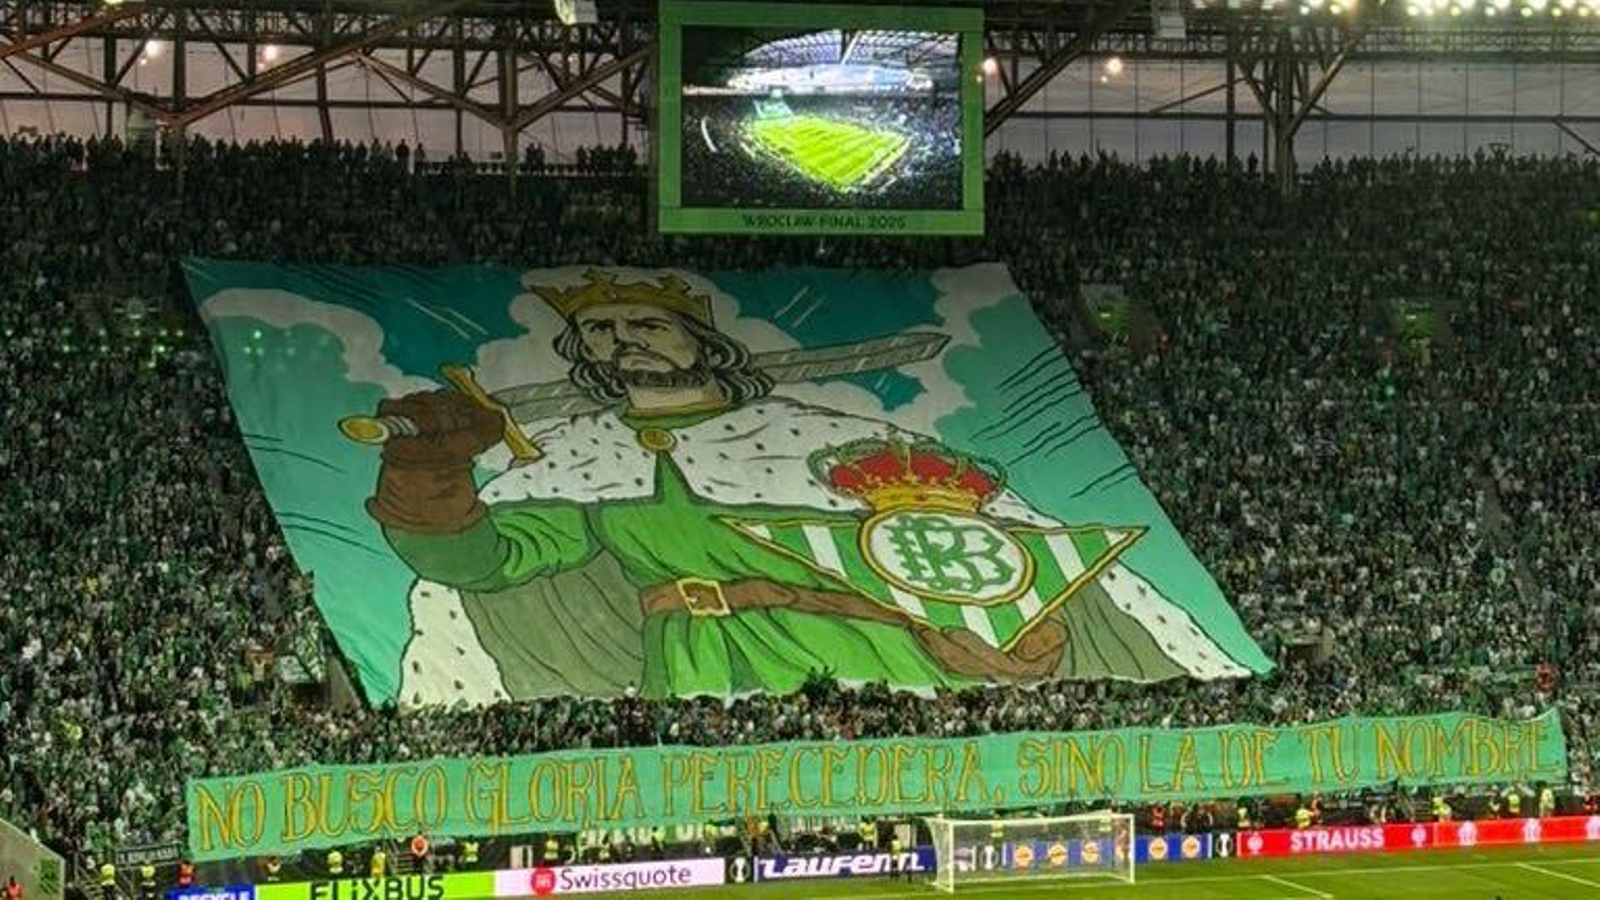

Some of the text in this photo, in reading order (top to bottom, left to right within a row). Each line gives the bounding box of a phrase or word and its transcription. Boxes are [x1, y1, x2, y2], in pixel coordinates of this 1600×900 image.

[820, 214, 863, 228] FINAL
[195, 716, 1562, 852] NO BUSCO GLORIA PERECEDERA, SINO LA DE TU NOMBRE
[1291, 828, 1385, 850] STRAUSS
[560, 865, 692, 890] Swissquote
